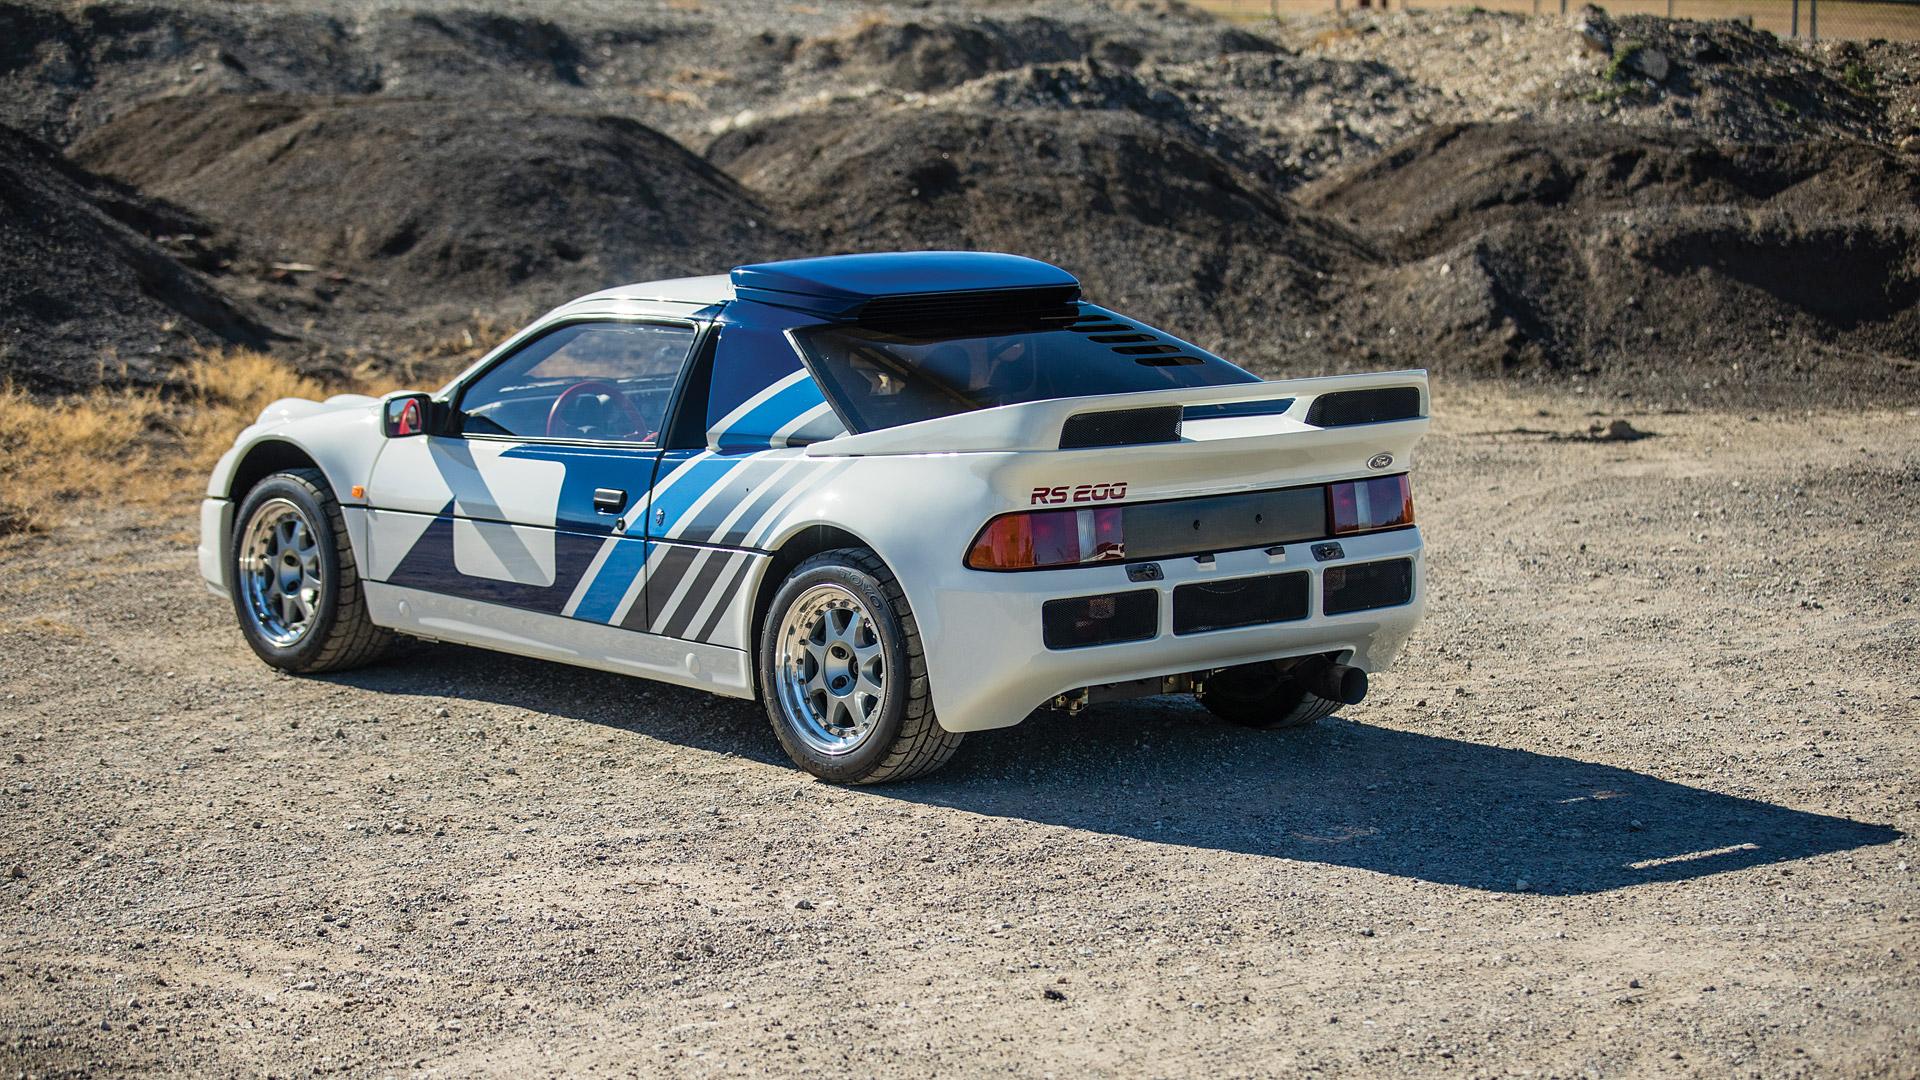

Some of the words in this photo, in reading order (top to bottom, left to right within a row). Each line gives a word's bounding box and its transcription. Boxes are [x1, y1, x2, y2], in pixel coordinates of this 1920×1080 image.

[1373, 455, 1391, 468] Ford
[1031, 486, 1070, 505] RS
[1073, 482, 1128, 503] 200
[840, 568, 883, 610] TOYO
